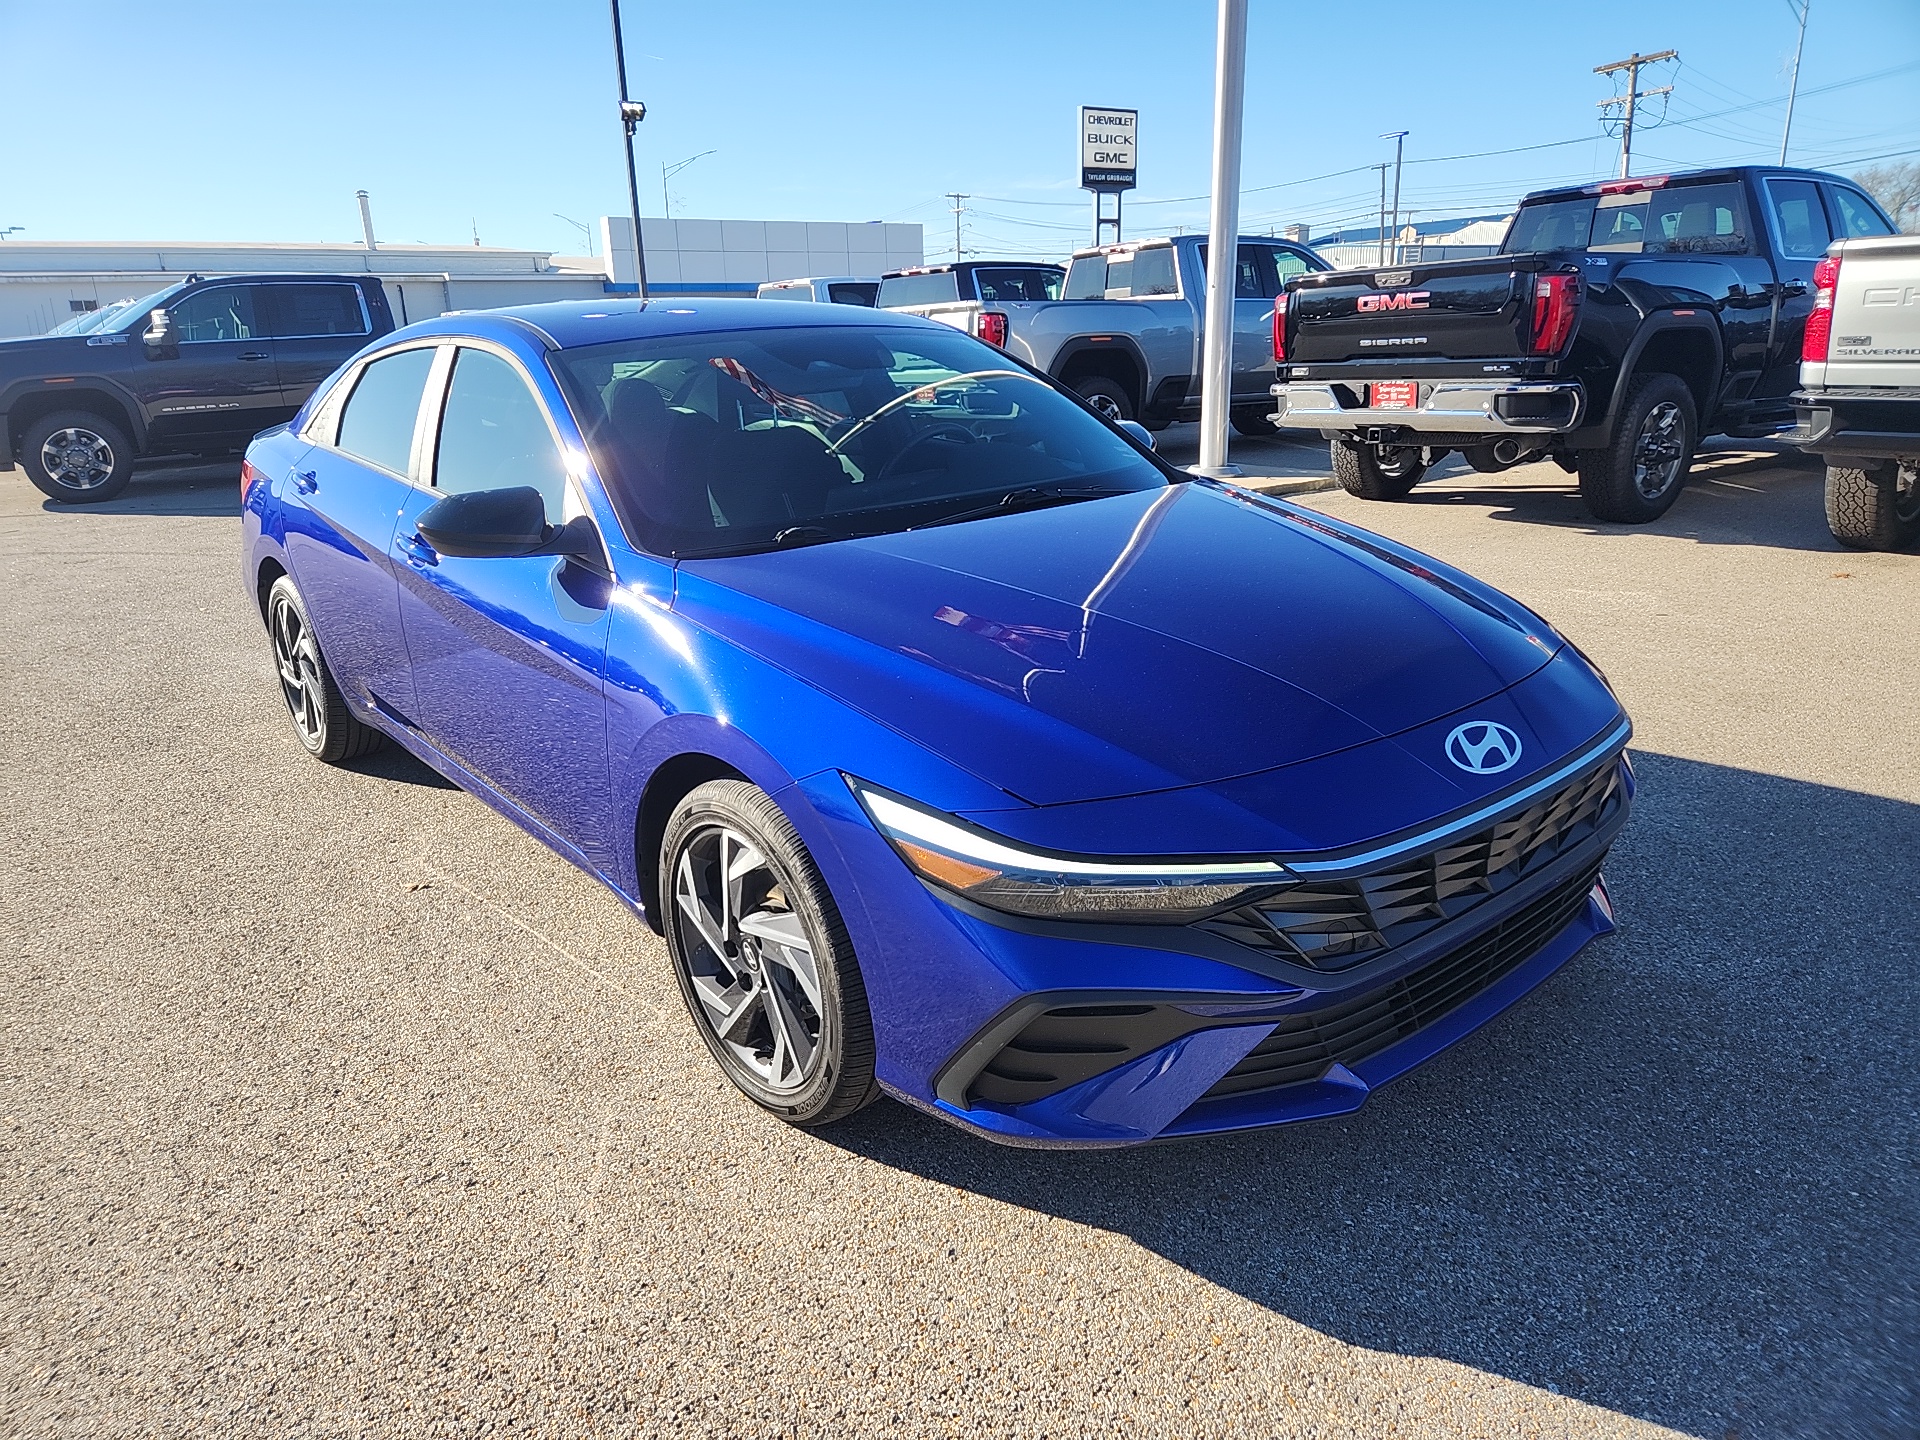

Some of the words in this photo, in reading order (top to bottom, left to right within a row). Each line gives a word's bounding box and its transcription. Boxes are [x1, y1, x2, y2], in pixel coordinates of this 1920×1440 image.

[1088, 115, 1134, 126] CHEVROLET
[1088, 133, 1133, 145] BUICK
[1094, 152, 1127, 163] GMC
[1358, 291, 1430, 312] GMC
[1360, 337, 1428, 346] SIERRA
